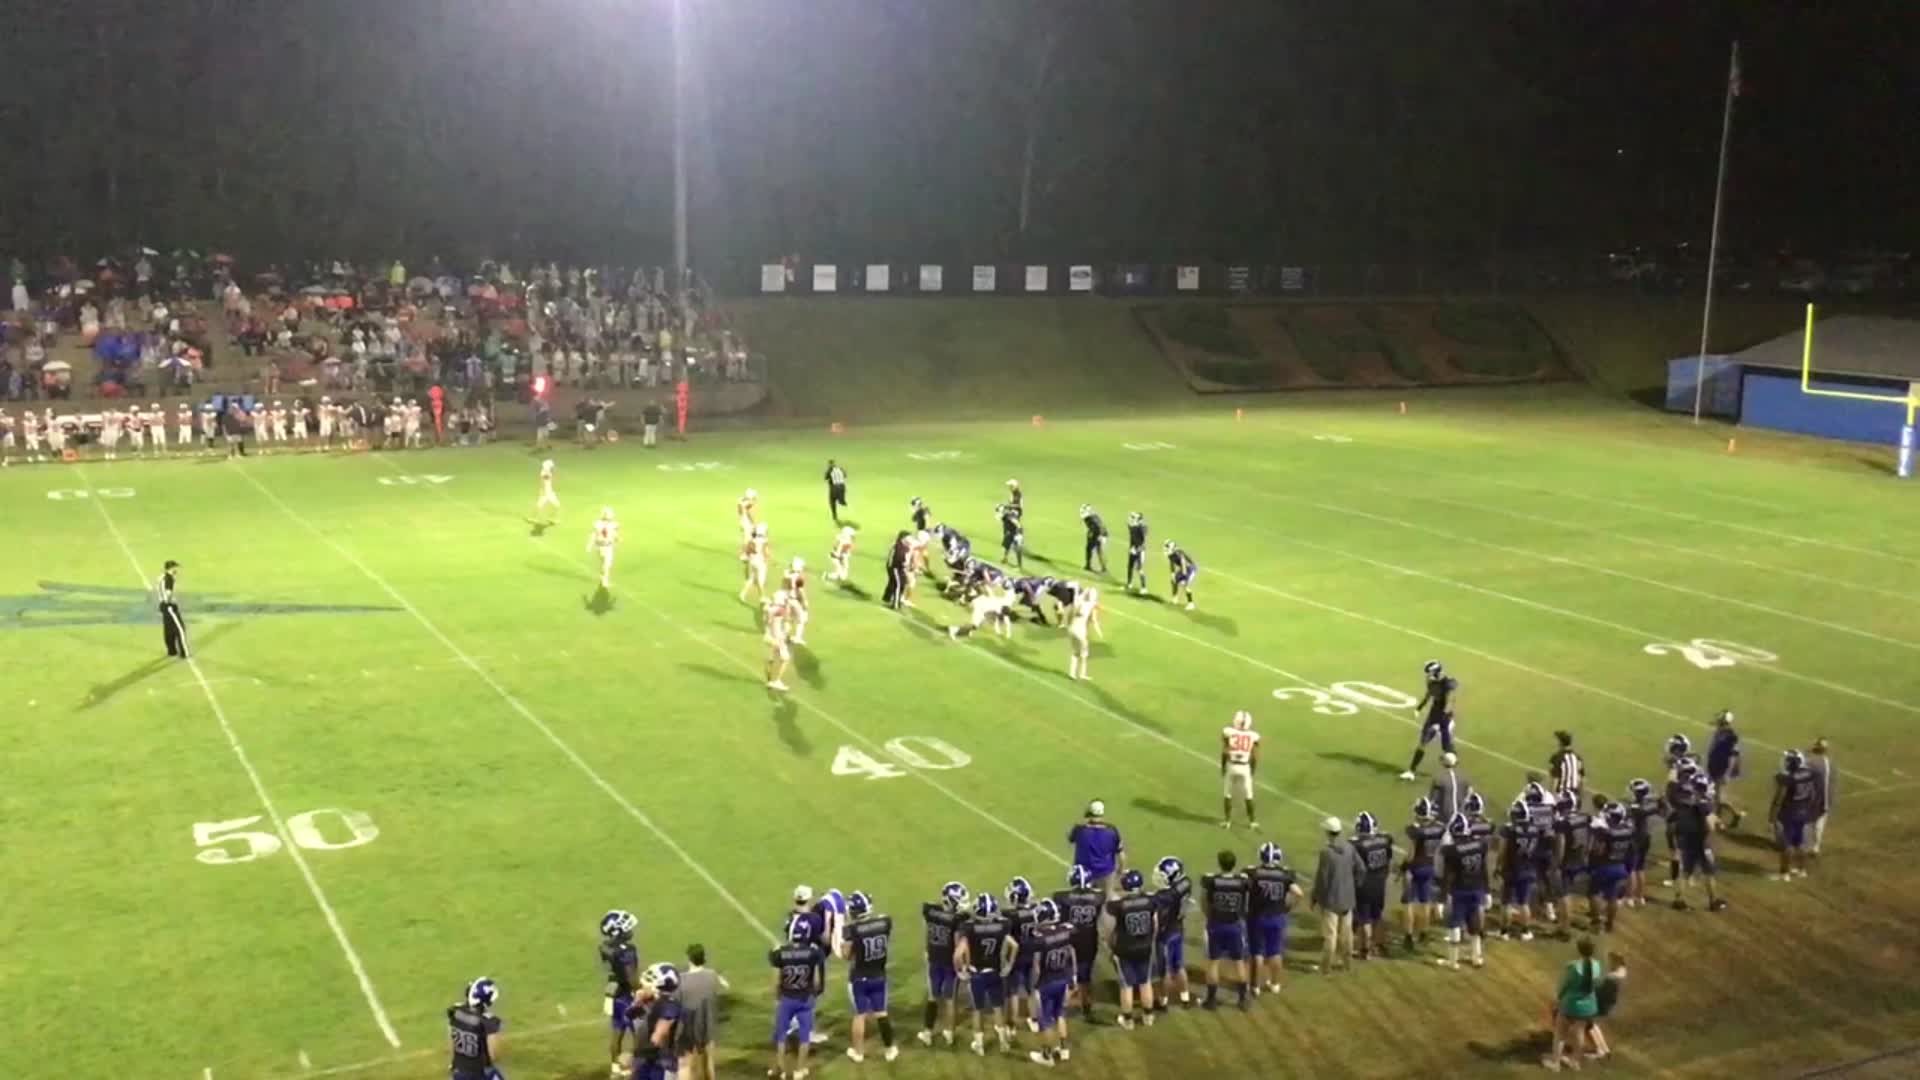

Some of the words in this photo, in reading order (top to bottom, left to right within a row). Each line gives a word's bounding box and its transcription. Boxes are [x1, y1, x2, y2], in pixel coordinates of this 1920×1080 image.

[1643, 638, 1778, 669] 20
[1272, 681, 1417, 715] 30
[831, 735, 971, 780] 40
[1231, 734, 1251, 752] 30
[193, 808, 379, 864] 50
[863, 935, 887, 962] 19
[981, 938, 997, 956] 7
